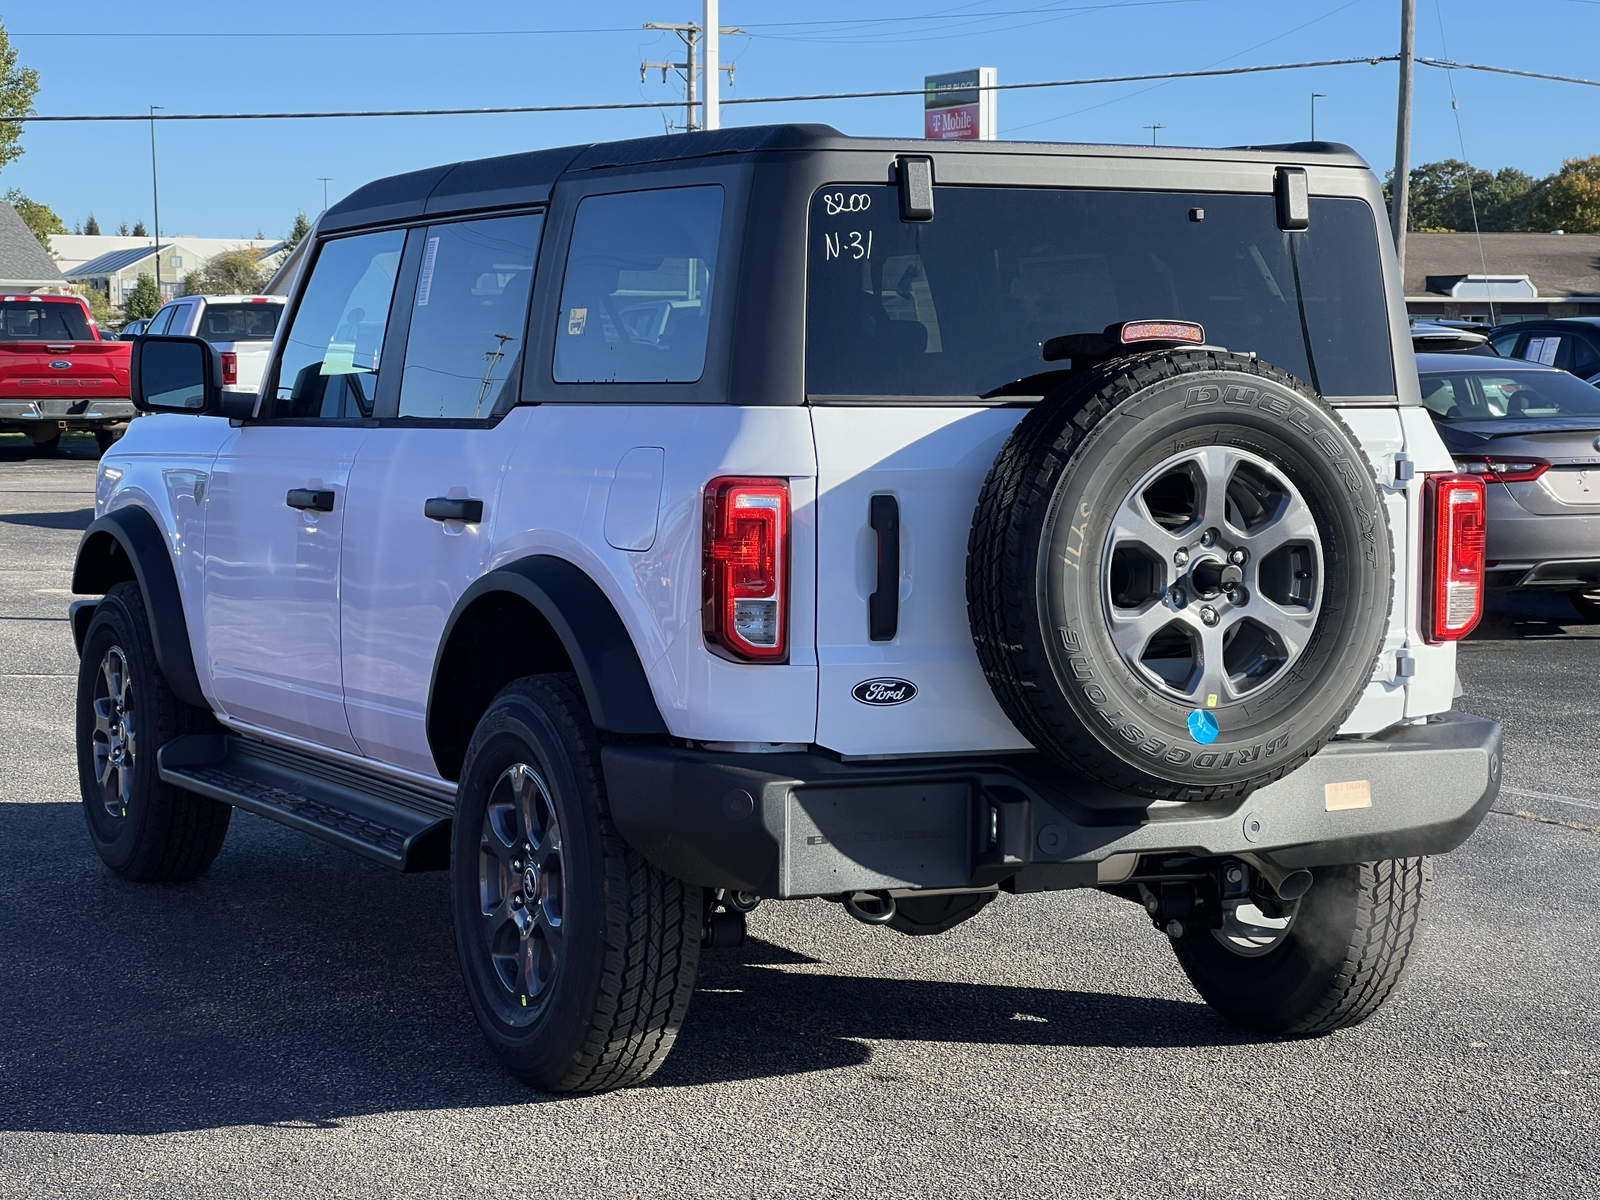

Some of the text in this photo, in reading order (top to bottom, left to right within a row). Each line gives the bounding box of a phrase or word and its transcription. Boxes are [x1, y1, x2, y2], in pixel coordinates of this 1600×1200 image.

[823, 192, 871, 215] 8200
[1184, 384, 1363, 495] DUELER
[865, 682, 906, 700] Ford
[1058, 627, 1292, 769] BRIDGESTONE
